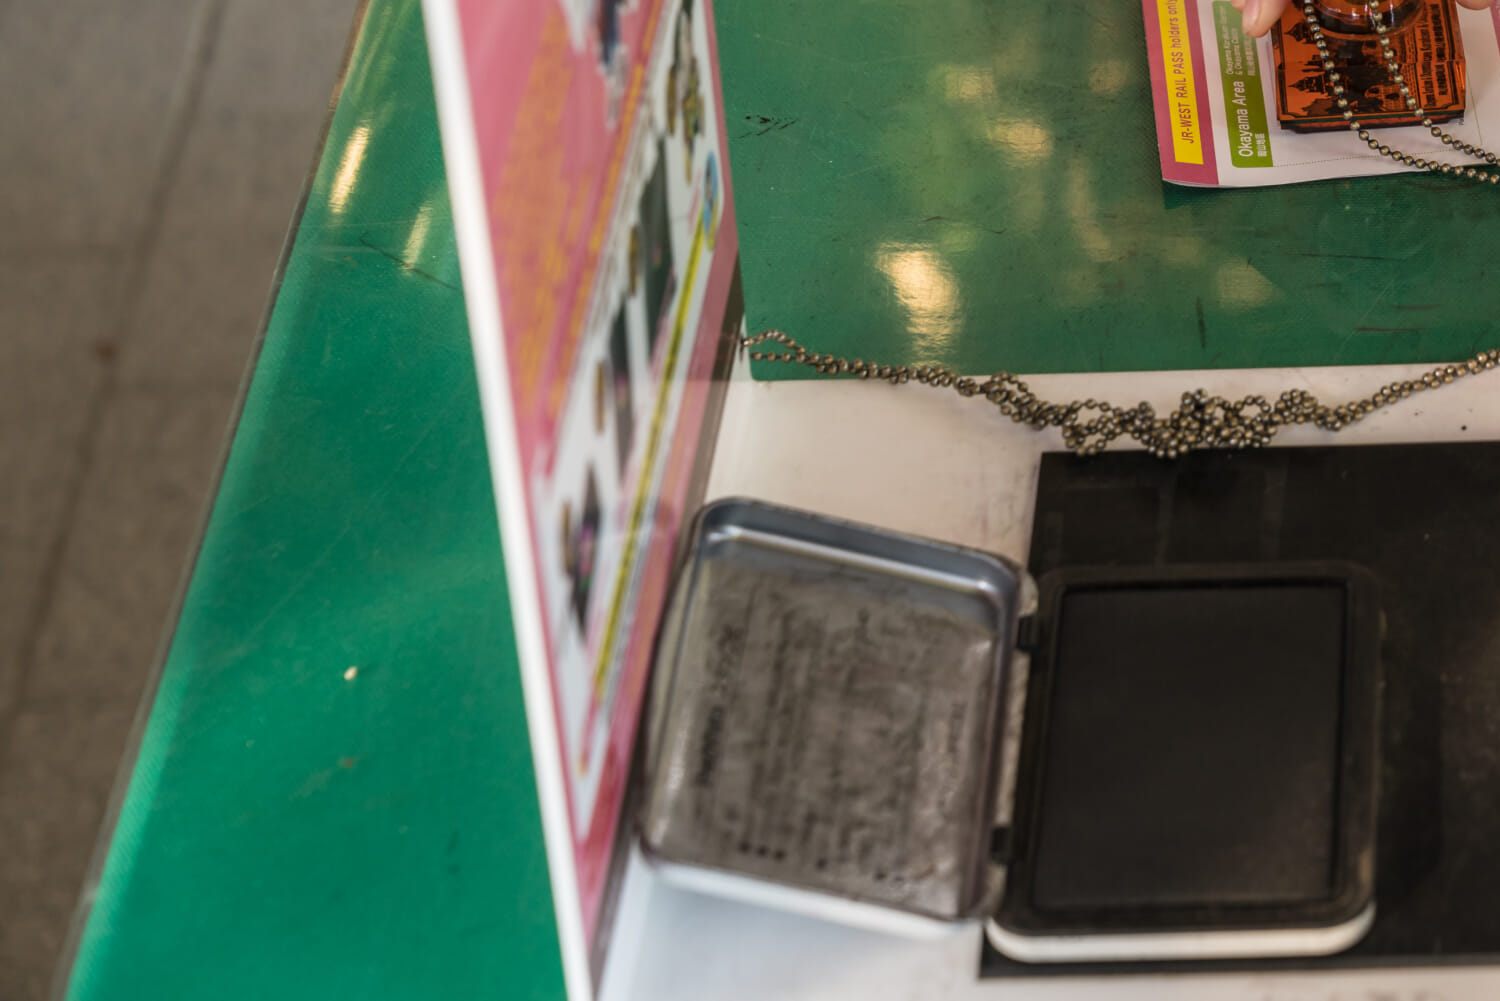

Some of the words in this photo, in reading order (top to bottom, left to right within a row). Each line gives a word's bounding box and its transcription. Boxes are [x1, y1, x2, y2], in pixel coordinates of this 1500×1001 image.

[1168, 18, 1182, 49] holders
[1171, 51, 1185, 75] PASS
[1176, 78, 1188, 99] RAIL
[1232, 81, 1247, 106] Area
[1177, 102, 1194, 144] JR-WEST
[1237, 108, 1253, 157] Okayama
